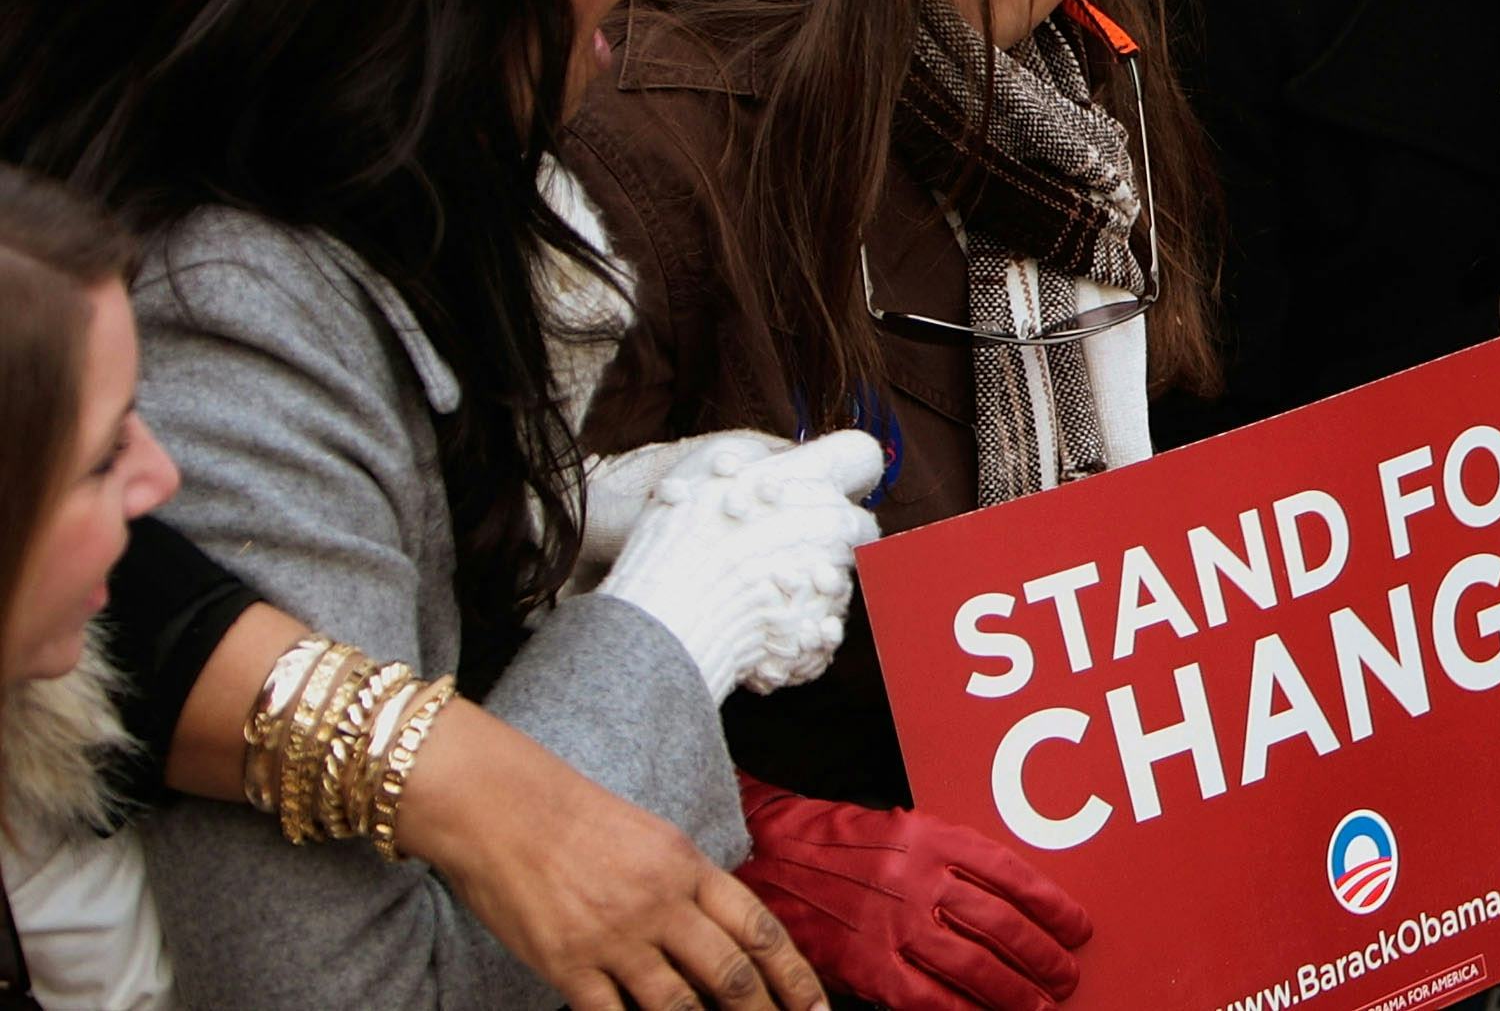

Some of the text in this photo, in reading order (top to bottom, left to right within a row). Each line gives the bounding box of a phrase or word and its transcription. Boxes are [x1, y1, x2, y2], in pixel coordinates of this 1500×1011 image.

[953, 490, 1350, 698] STAND
[1408, 984, 1430, 1005] FOR
[1431, 964, 1478, 994] AMERICA
